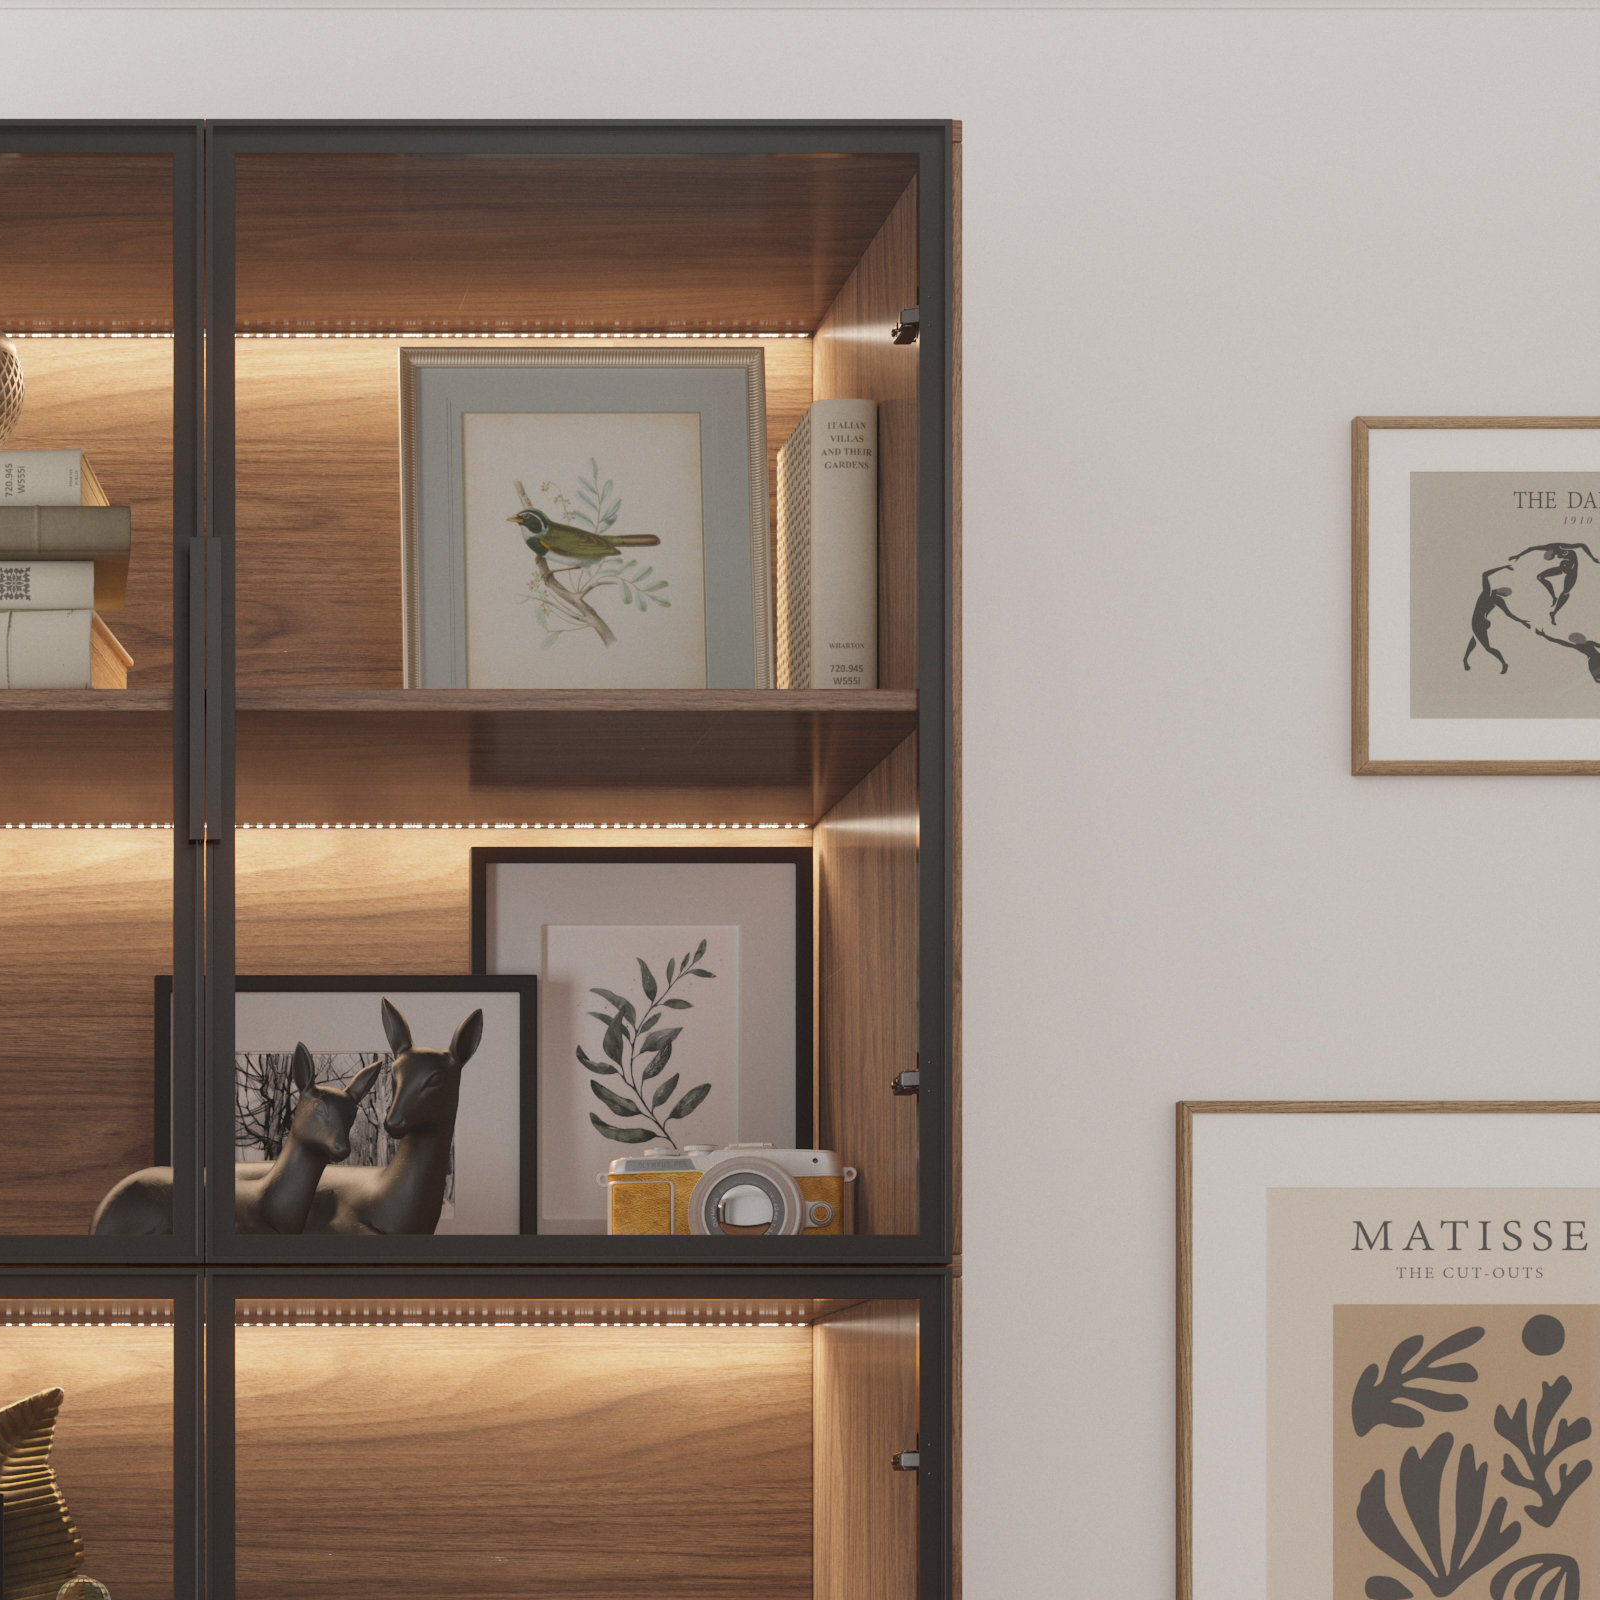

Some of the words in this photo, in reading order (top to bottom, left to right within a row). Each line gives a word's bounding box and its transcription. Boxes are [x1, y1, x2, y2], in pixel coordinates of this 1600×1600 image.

[827, 421, 866, 430] ITALIAN
[830, 434, 864, 442] VILLAS
[821, 448, 841, 456] AND
[843, 448, 872, 456] THEIR
[824, 461, 870, 470] GARDENS
[5, 463, 13, 497] 720.945
[1513, 491, 1557, 509] THE
[1567, 491, 1600, 509] DA
[1563, 516, 1593, 525] 1910
[829, 664, 864, 673] 720.945
[1351, 1220, 1588, 1251] MATISSE
[1396, 1266, 1435, 1279] THE
[1443, 1266, 1544, 1279] CUT-OUTS
